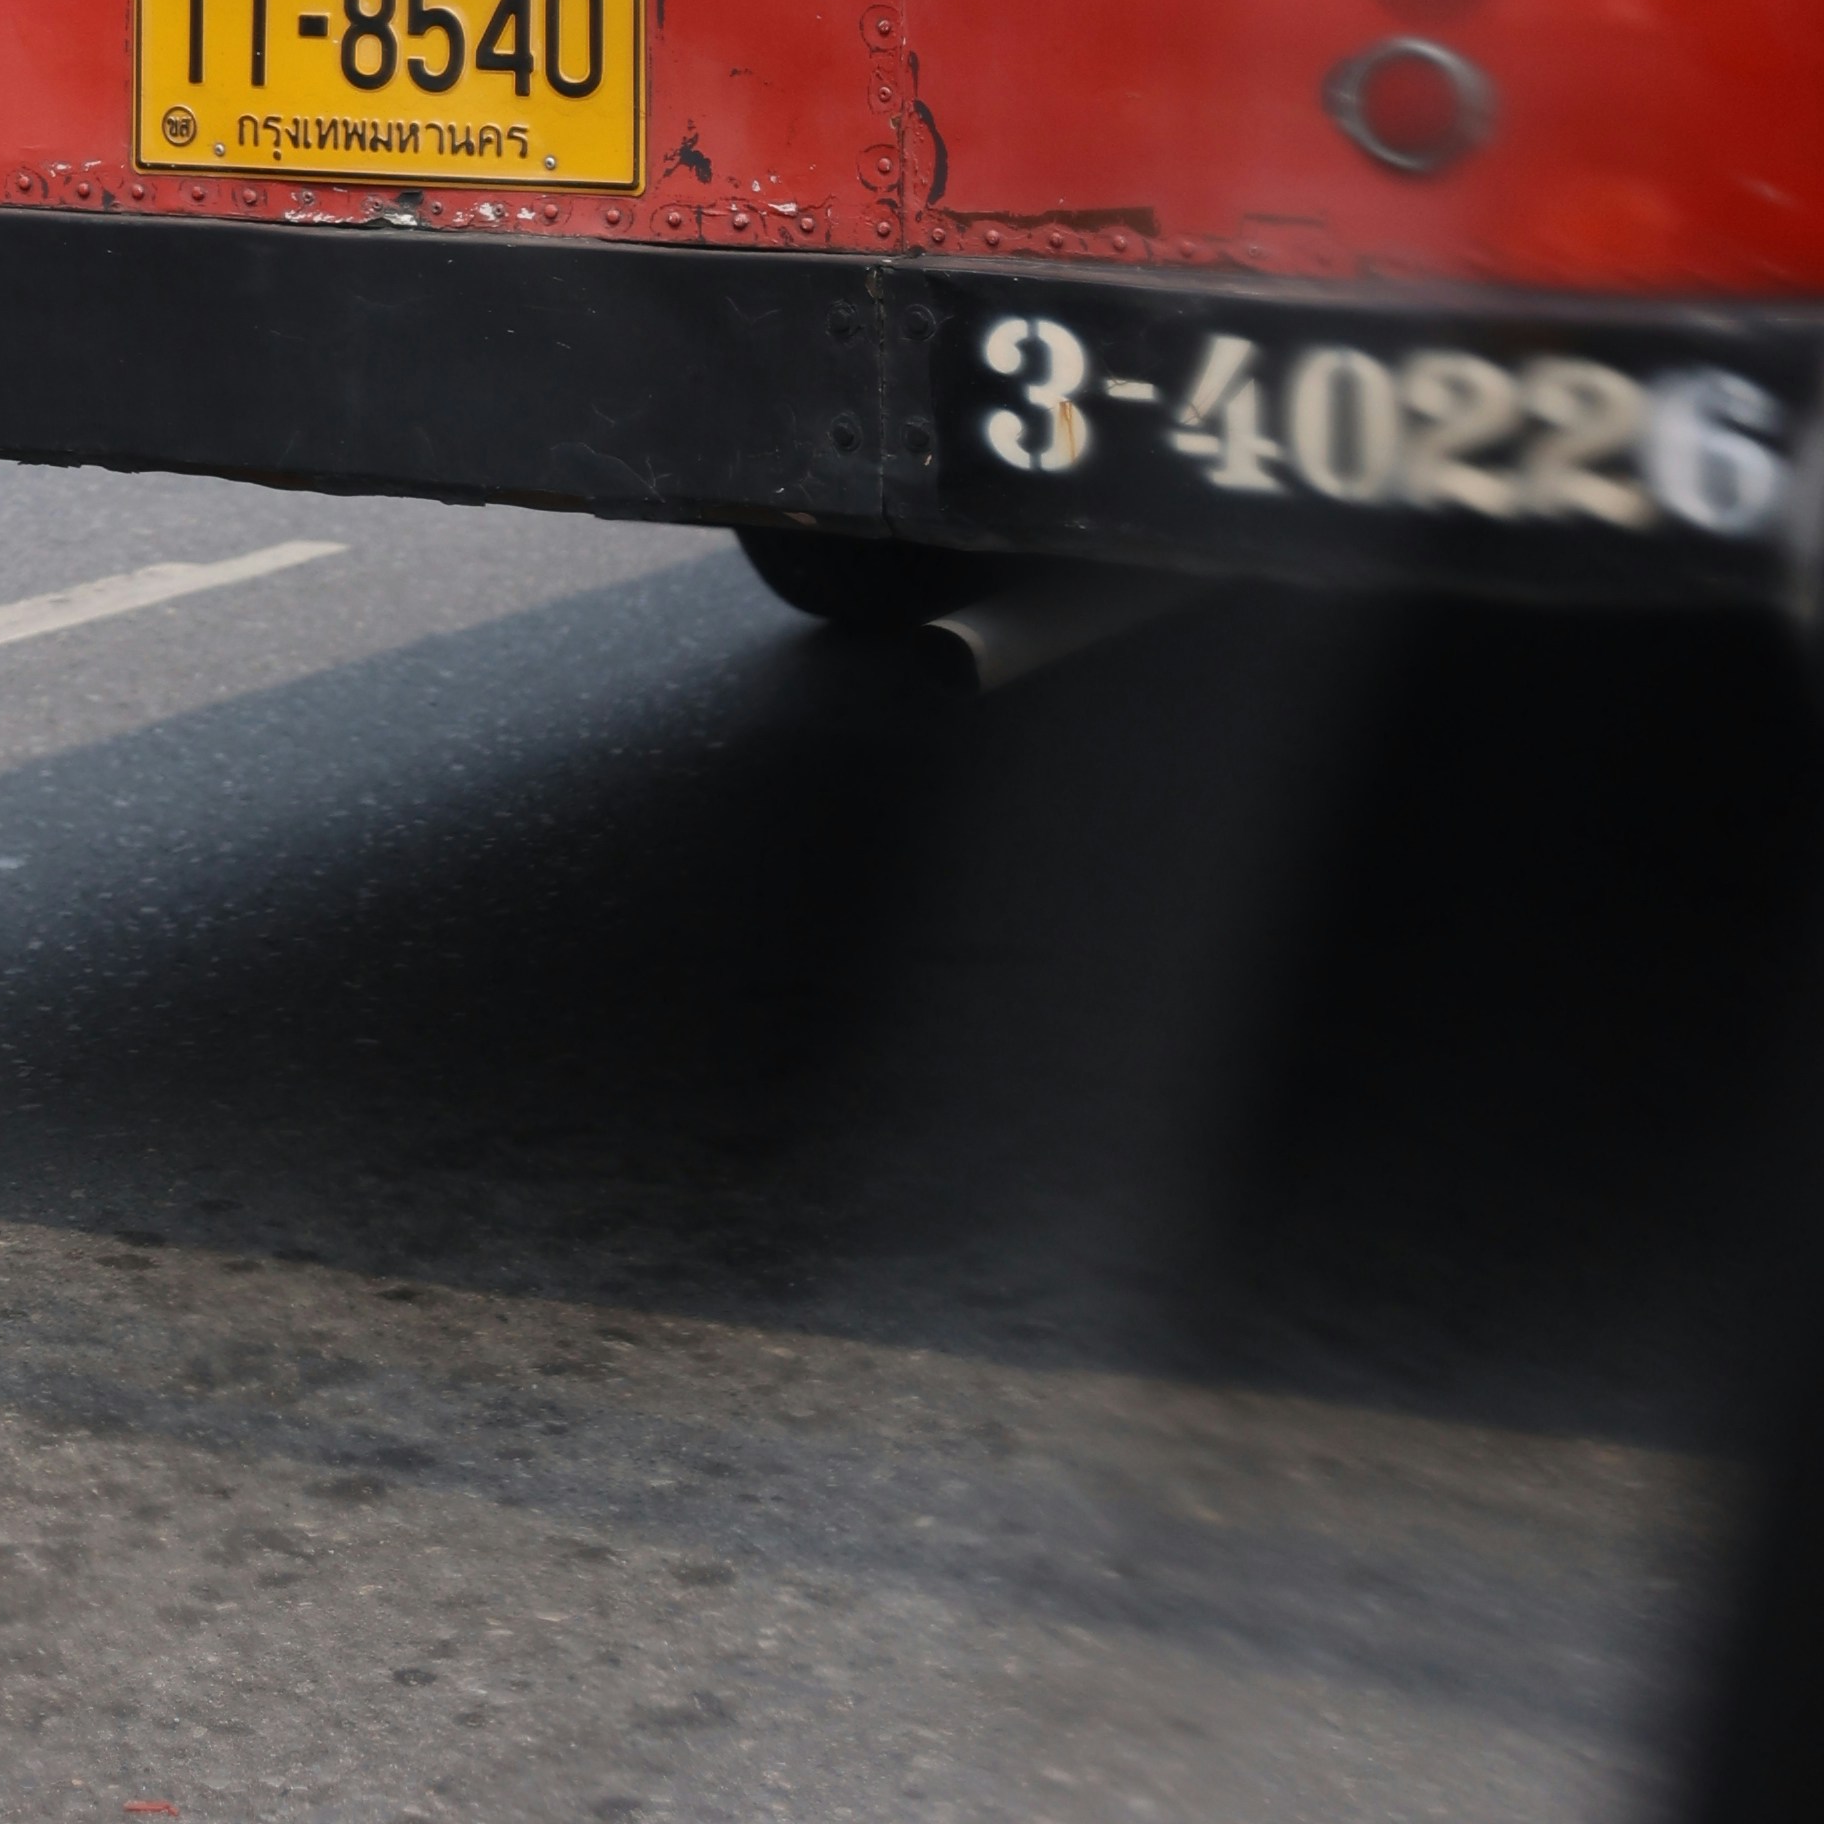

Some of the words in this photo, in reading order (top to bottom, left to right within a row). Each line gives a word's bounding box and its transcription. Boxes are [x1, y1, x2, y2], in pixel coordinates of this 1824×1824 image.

[237, 113, 530, 161] กรุงเทพมหานคร
[983, 316, 1788, 538] 3-40226
